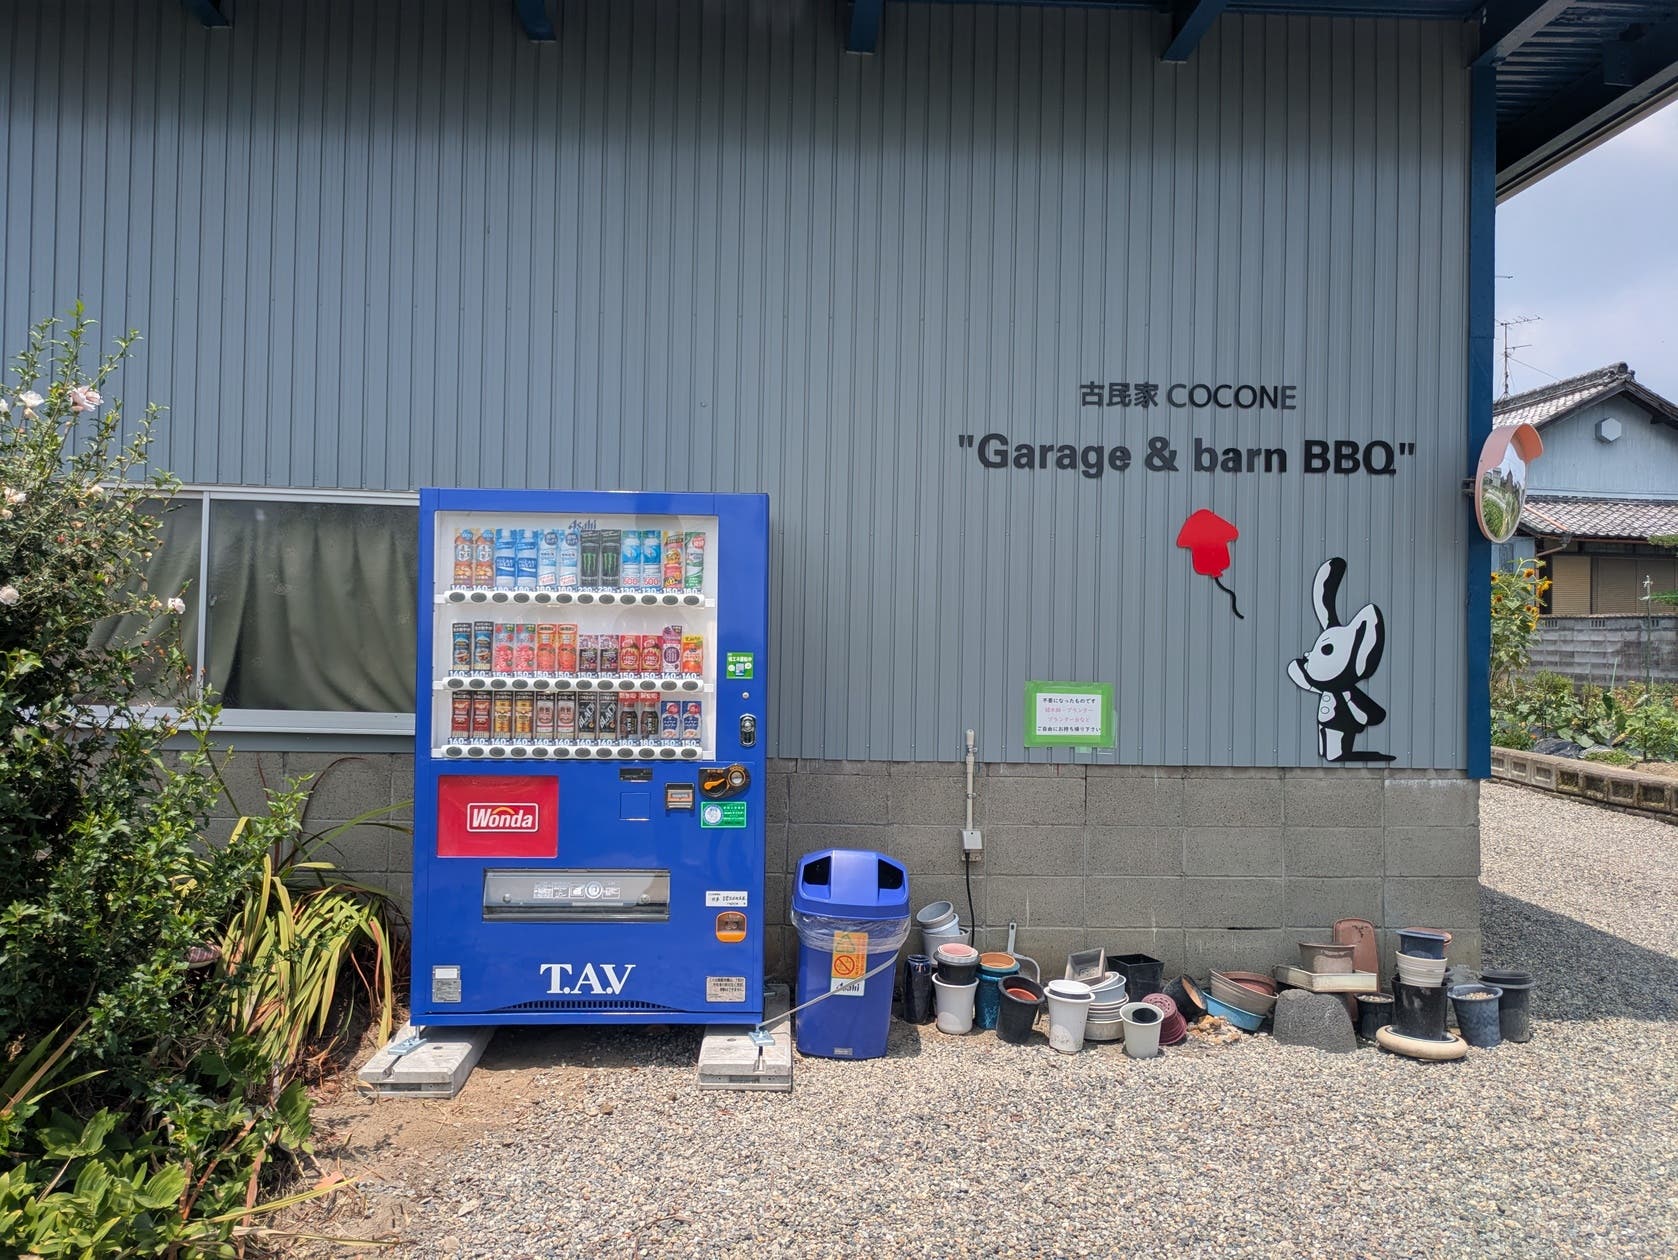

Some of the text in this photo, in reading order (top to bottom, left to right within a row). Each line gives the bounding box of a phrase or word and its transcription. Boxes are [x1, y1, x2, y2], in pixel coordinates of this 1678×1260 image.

[1079, 381, 1298, 410] 古民家 COCONE
[957, 432, 1416, 478] "Garage & barn BBQ"
[472, 808, 533, 828] Wonda
